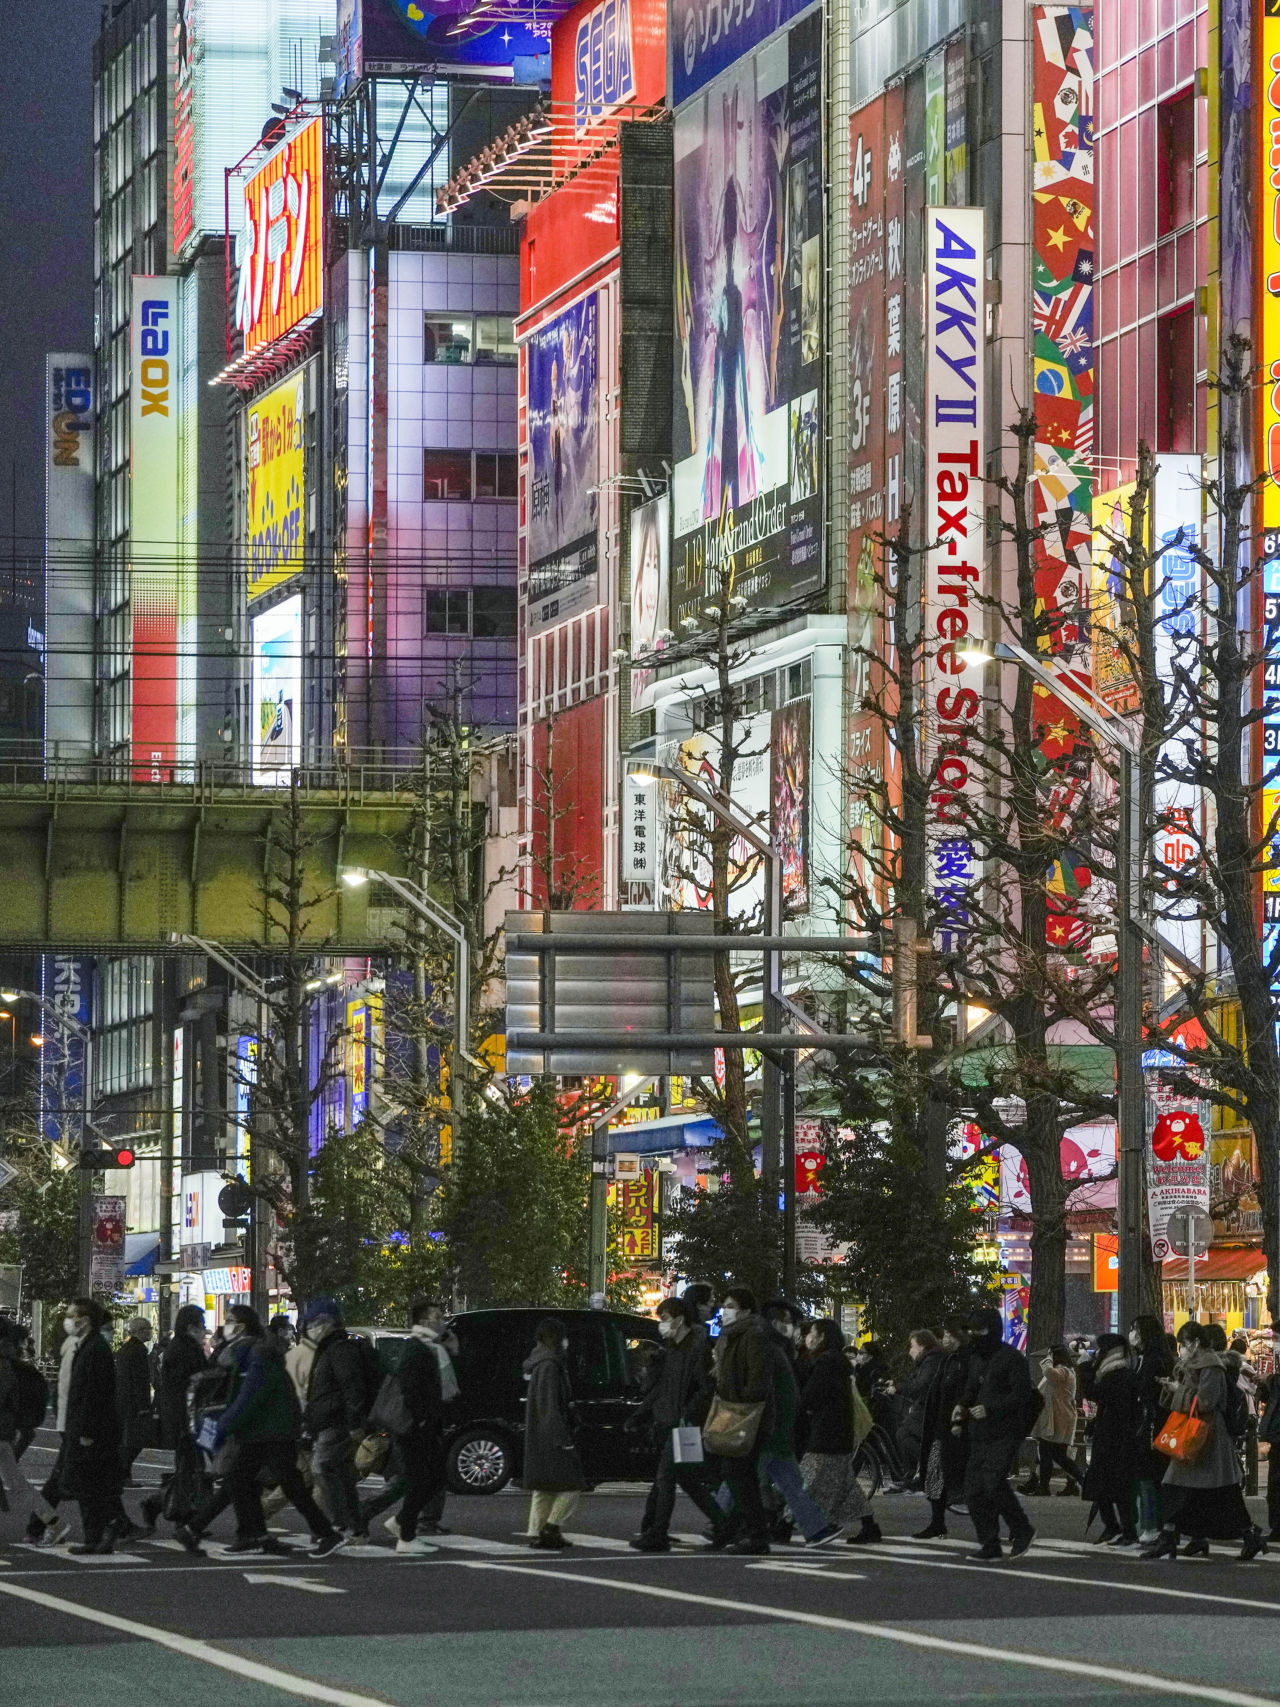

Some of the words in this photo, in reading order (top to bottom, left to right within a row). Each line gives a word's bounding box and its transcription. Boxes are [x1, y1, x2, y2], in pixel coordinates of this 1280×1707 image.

[367, 62, 393, 72] 秋葉原
[575, 0, 637, 141] SEGA
[853, 133, 872, 206] 4F
[851, 213, 883, 253] カードゲーム
[851, 247, 883, 288] オンラインゲーム
[887, 216, 901, 435] 秋葉原
[935, 218, 977, 391] AKKY
[53, 368, 91, 467] EDION
[852, 378, 871, 451] 3F
[756, 482, 787, 540] Order
[936, 439, 979, 676] Tax-free
[1162, 522, 1196, 637] SEGA
[1152, 1164, 1205, 1175] Welcome!
[1159, 1187, 1207, 1196] AKIHABARA
[640, 1230, 650, 1254] 2F
